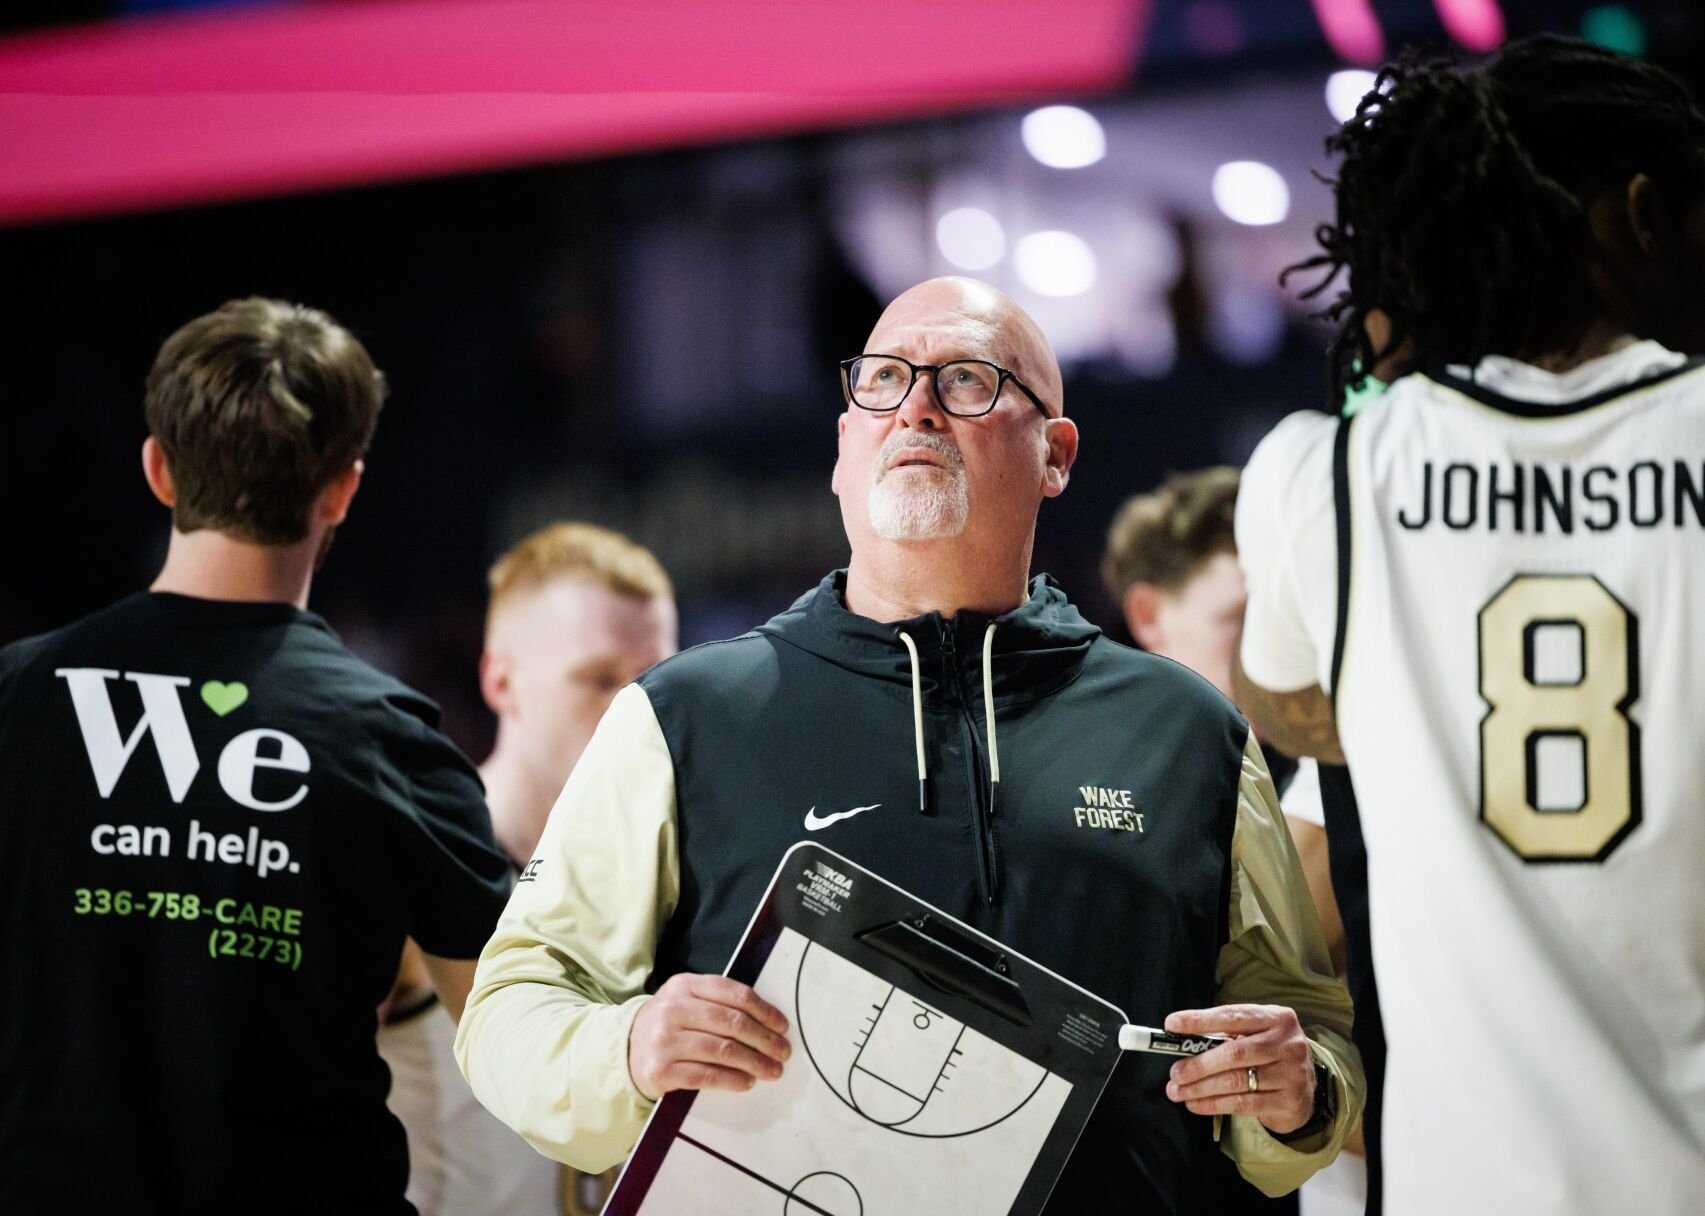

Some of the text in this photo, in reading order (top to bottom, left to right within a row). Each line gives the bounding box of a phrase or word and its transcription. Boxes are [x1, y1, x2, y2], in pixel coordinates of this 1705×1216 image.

[1398, 458, 1705, 535] JOHNSON
[54, 667, 312, 813] We
[1476, 572, 1645, 865] 8
[1079, 785, 1135, 809] WAKE
[1073, 806, 1144, 833] FOREST
[90, 820, 301, 878] can help.
[796, 883, 842, 912] BASKETBALL
[803, 869, 851, 899] PLAYMAKER
[73, 888, 303, 935] 336-758-CARE
[208, 928, 303, 970] (2273)
